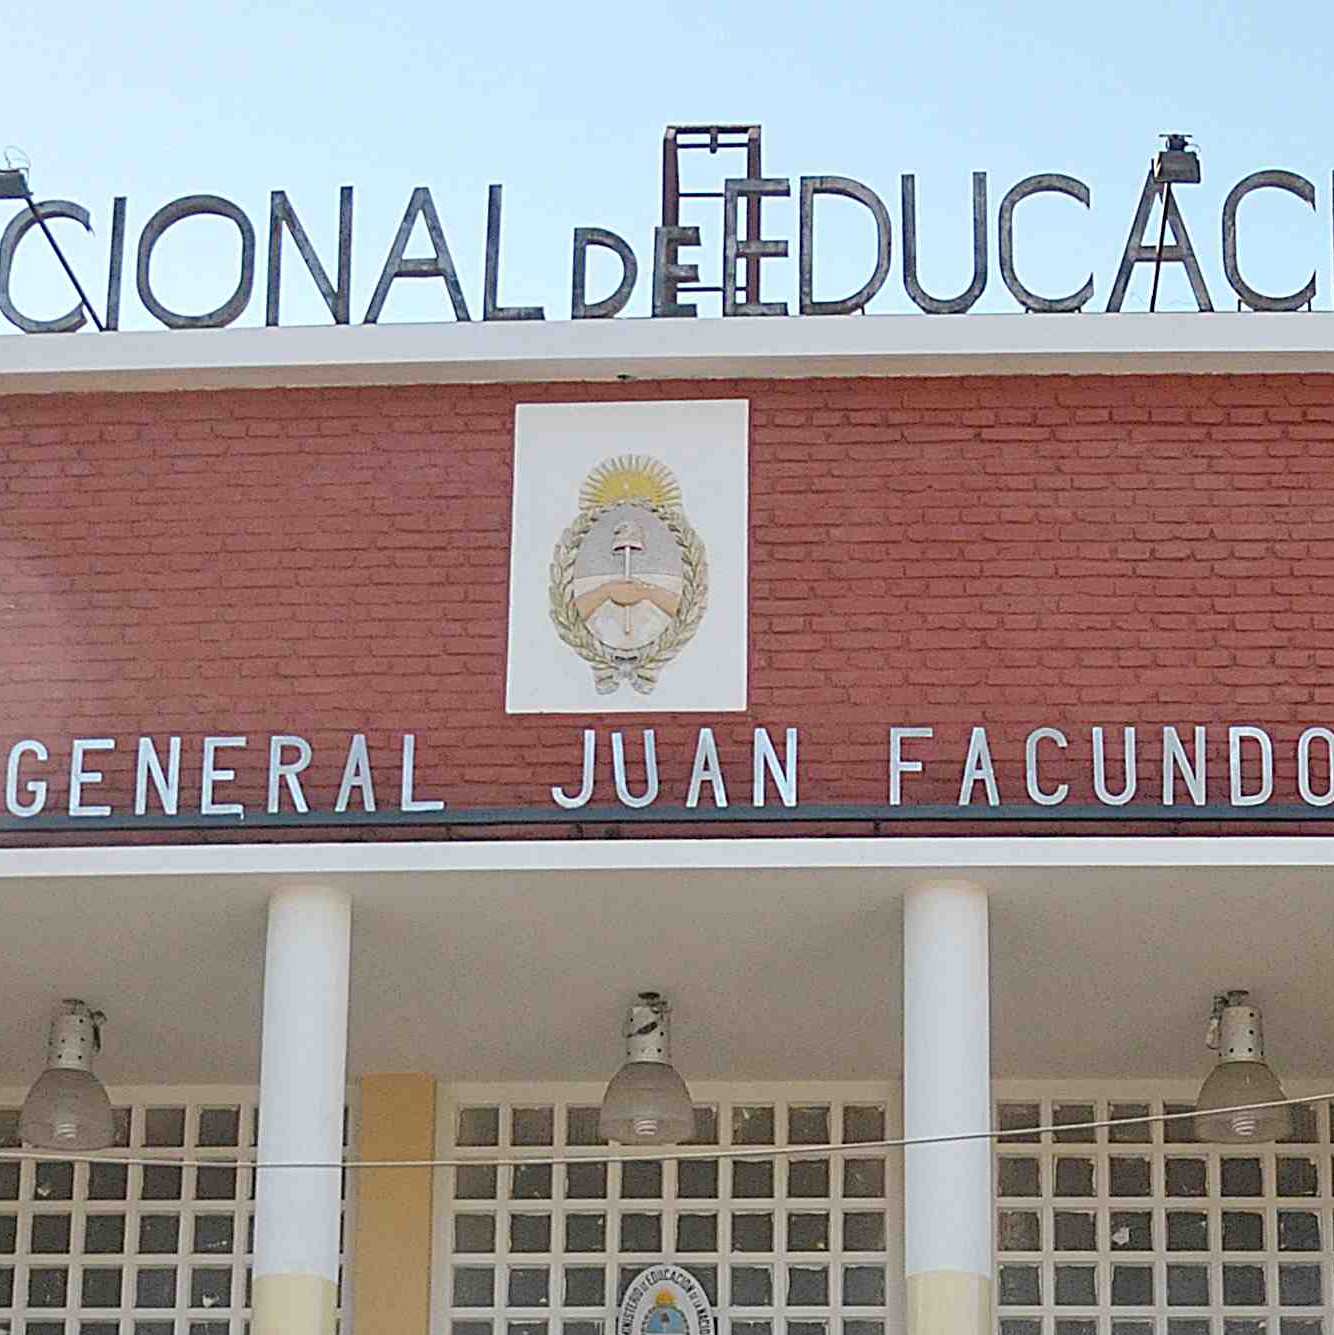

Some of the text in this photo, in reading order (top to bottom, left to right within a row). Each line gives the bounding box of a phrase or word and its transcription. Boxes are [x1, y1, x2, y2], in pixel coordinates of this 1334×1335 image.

[571, 226, 699, 319] DE
[4, 733, 446, 818] GENERAL
[549, 727, 799, 808] JUAN
